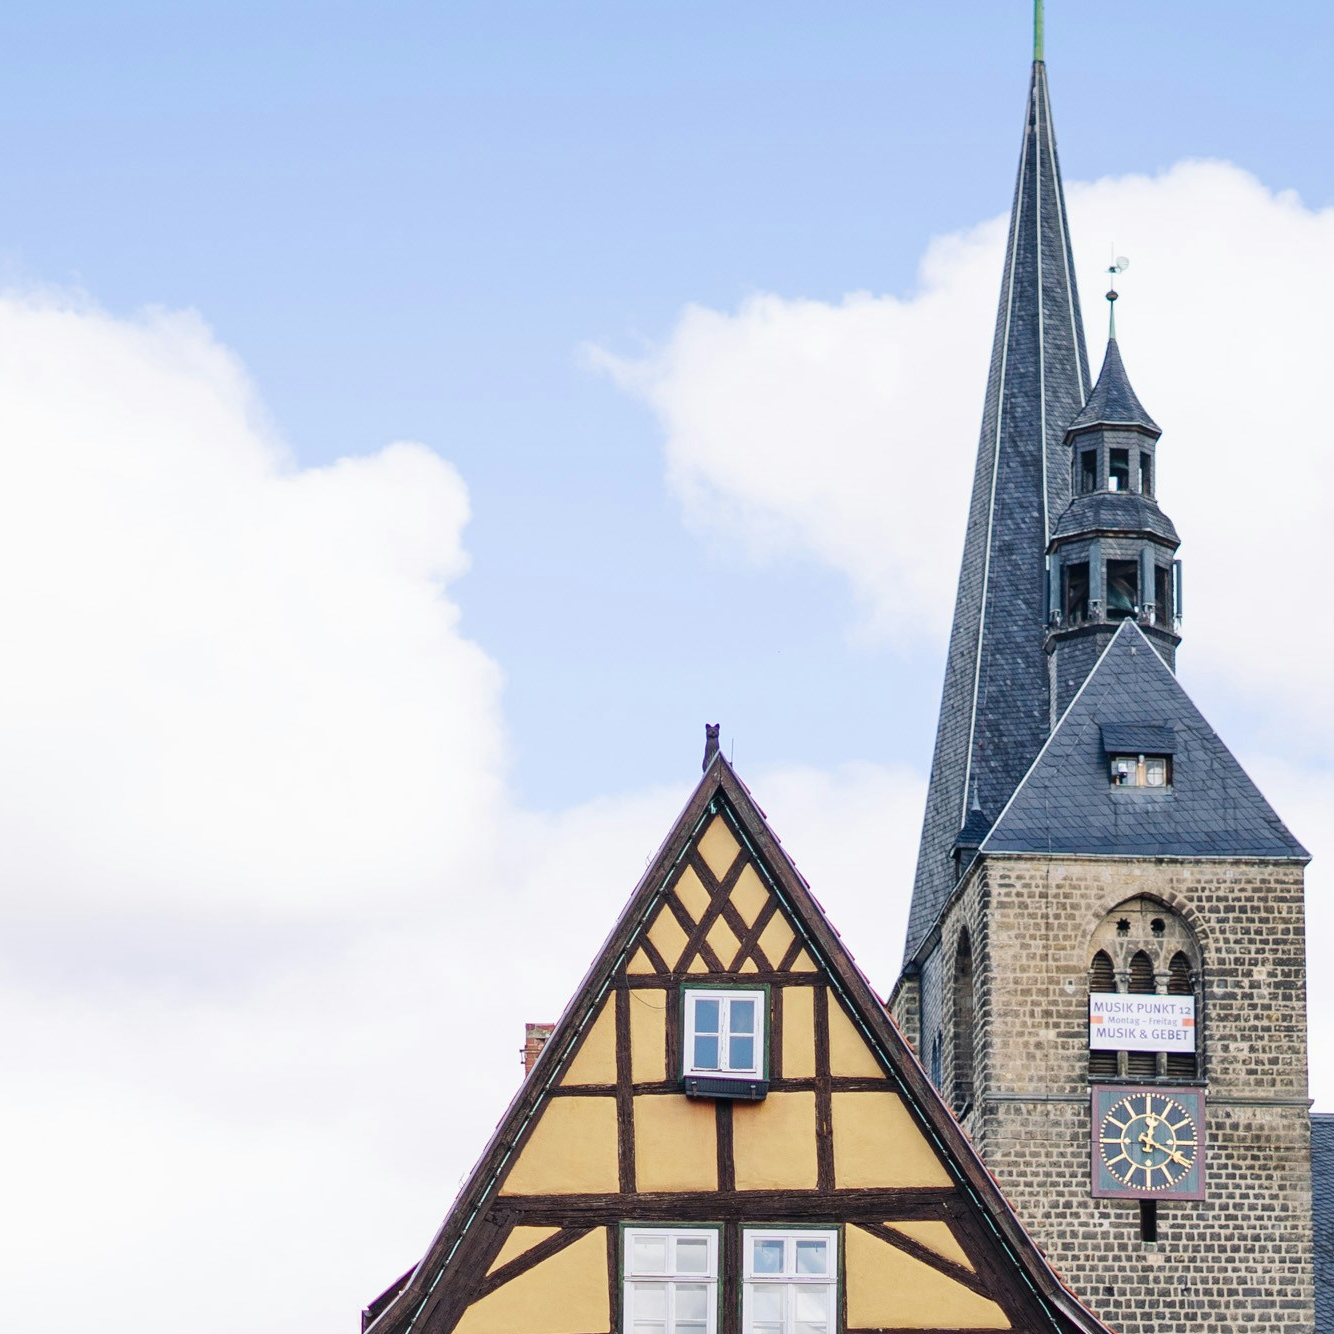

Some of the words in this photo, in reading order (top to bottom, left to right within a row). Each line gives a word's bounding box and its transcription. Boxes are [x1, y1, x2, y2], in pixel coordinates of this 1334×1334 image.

[1093, 1002, 1134, 1013] MUSIK
[1137, 1003, 1176, 1014] PUNKT
[1108, 1016, 1140, 1026] Montag
[1148, 1017, 1178, 1027] Freitag
[1096, 1027, 1136, 1039] MUSIK
[1139, 1029, 1147, 1039] &
[1152, 1029, 1189, 1040] GEBET
